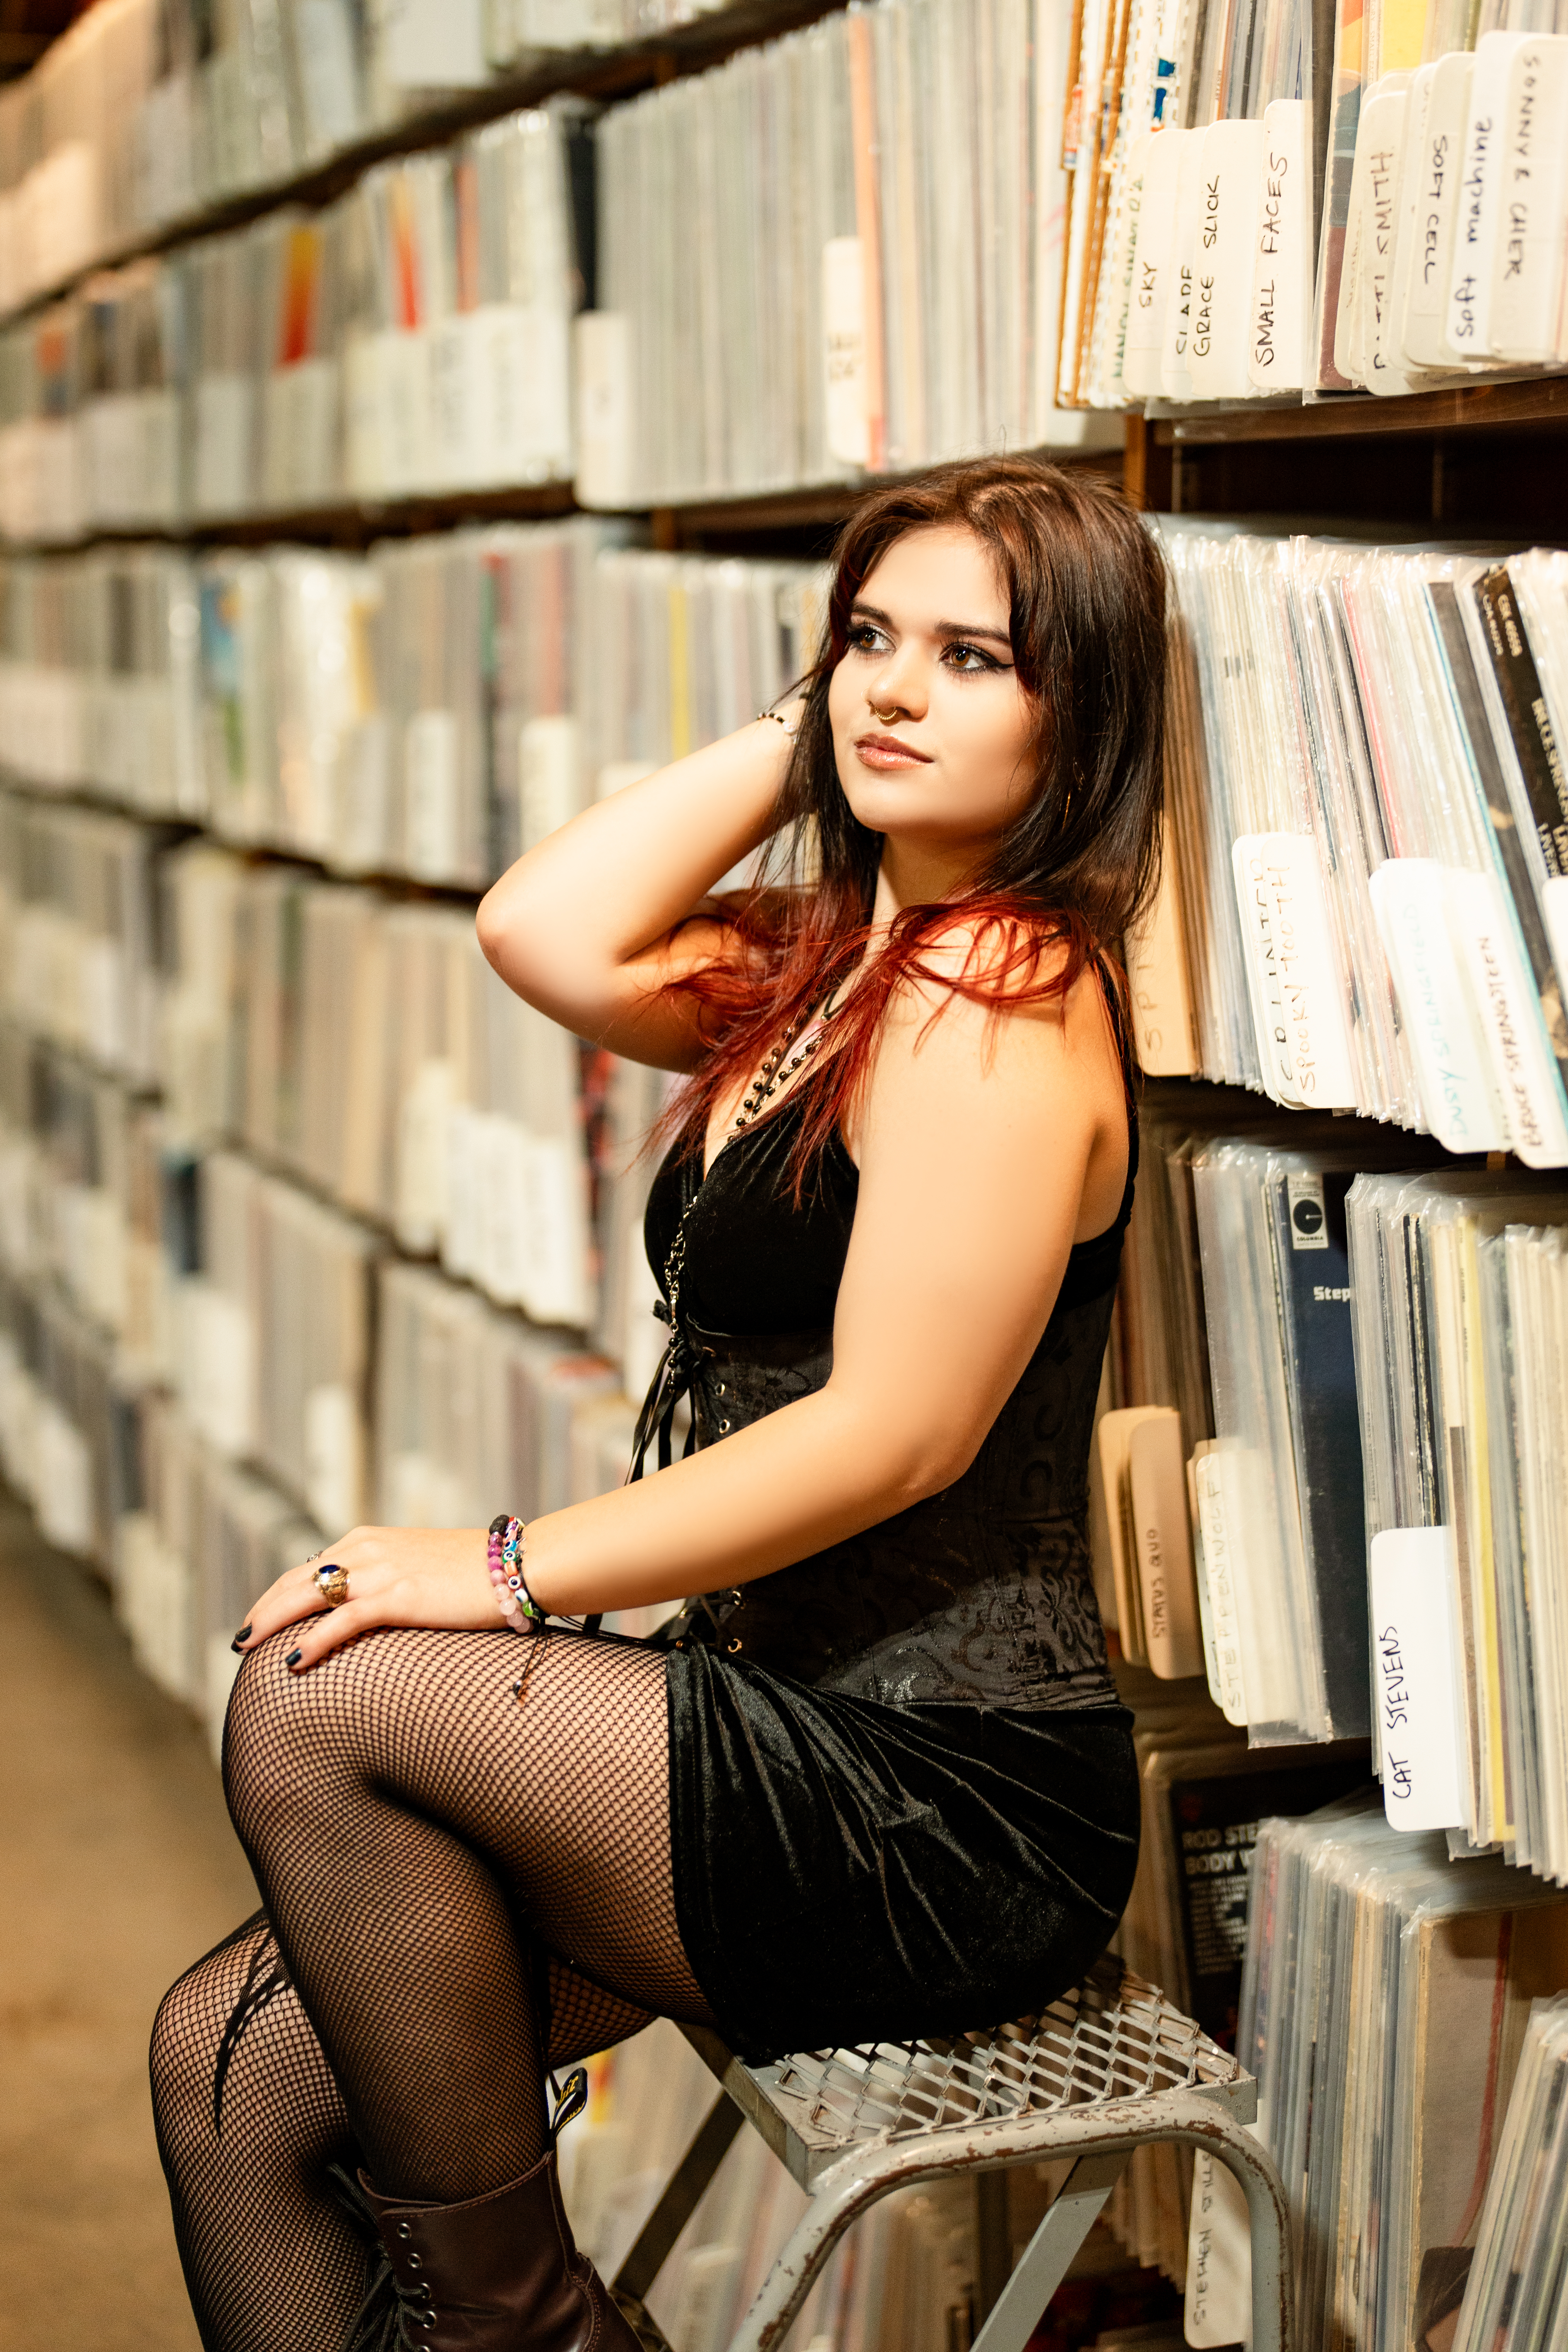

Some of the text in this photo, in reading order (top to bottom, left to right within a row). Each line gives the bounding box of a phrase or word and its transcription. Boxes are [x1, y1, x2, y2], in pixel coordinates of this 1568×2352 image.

[1516, 55, 1539, 156] SONNY
[1424, 135, 1448, 284] SOFT CELL
[1464, 116, 1492, 243] machine
[1139, 262, 1157, 308] SKY
[1193, 175, 1220, 356] GRACE SLICK
[1255, 152, 1288, 368] SMALL FACES
[1504, 203, 1527, 281] CHER
[1373, 275, 1386, 370] PTTI
[1265, 865, 1316, 1094] SPOOKY TOOTH
[1402, 902, 1470, 1137] DUSTY SPRINGFIELD
[1477, 936, 1522, 1074] SPRINGSTEEN
[1507, 1078, 1545, 1150] BRUCE
[1313, 1286, 1350, 1303] Step
[1150, 1576, 1166, 1638] STATUS
[1207, 1480, 1241, 1708] STEPPENWOLF
[1379, 1625, 1411, 1800] CAT STEVENS
[1183, 1828, 1222, 1850] ROD
[1185, 1850, 1236, 1875] BODY
[1192, 2227, 1212, 2326] STEPHEN
